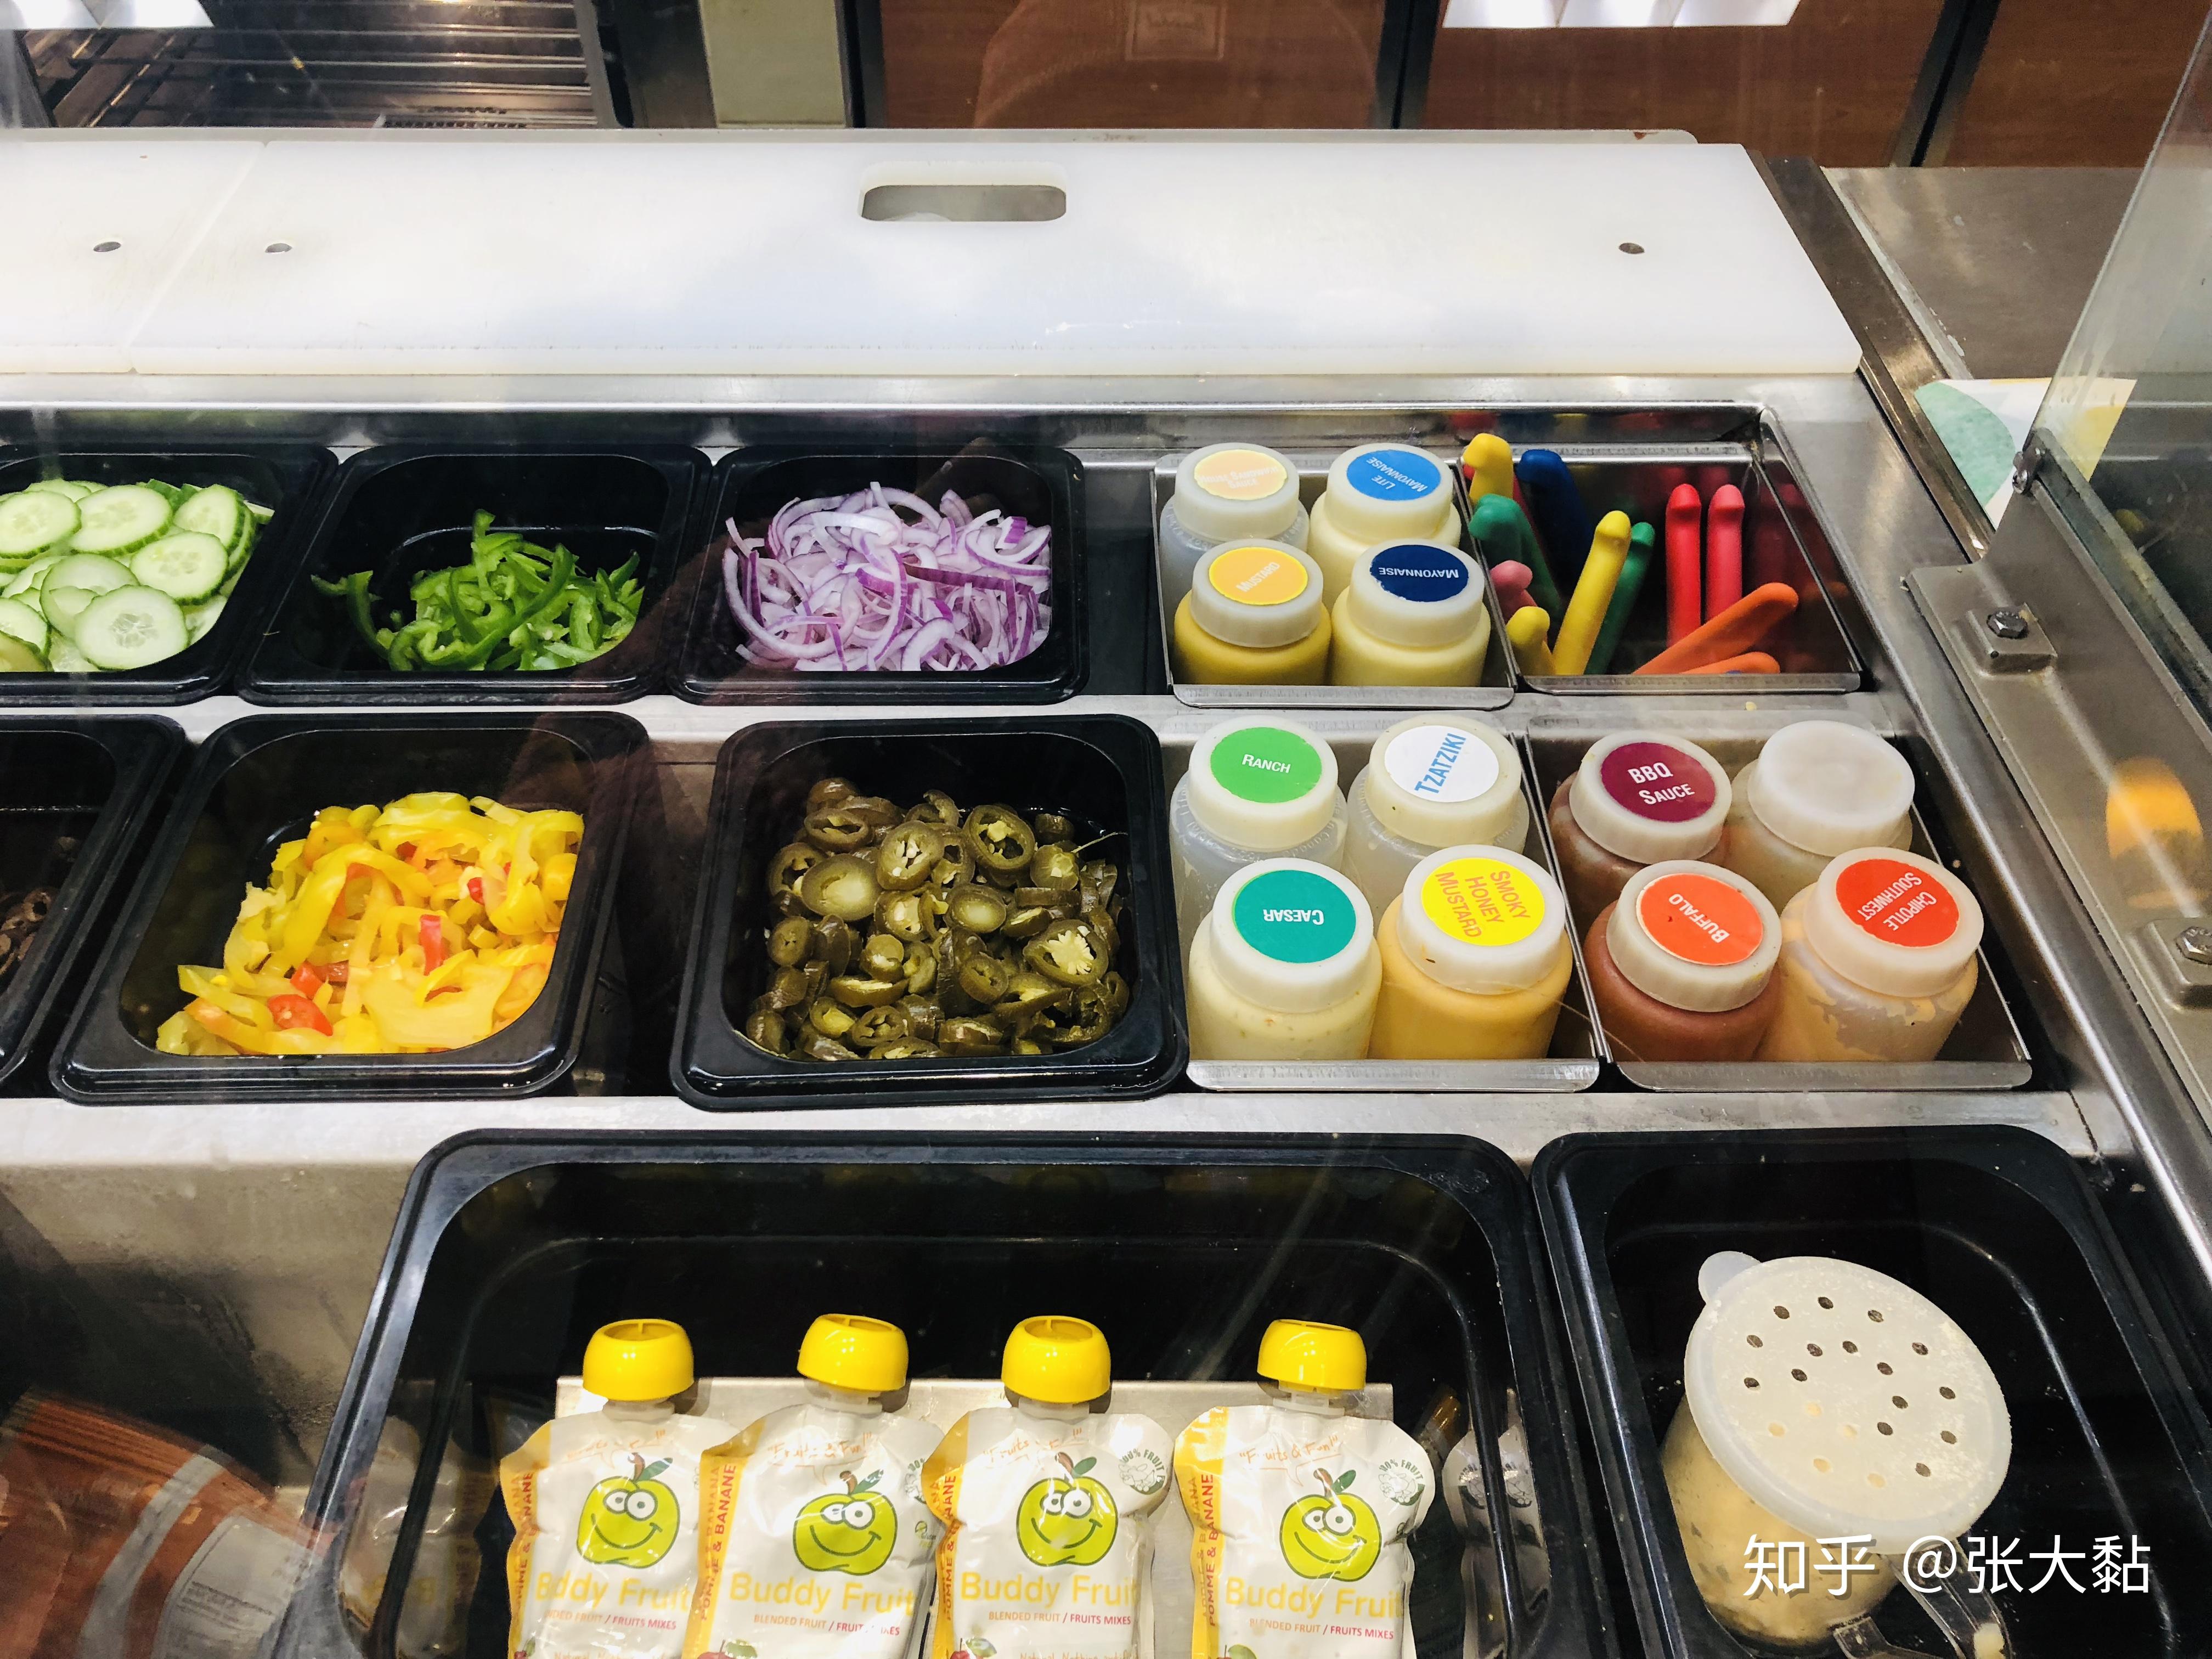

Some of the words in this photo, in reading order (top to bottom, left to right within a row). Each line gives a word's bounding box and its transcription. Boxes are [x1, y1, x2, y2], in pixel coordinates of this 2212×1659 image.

[1366, 457, 1428, 492] MAYONNAISE
[1371, 475, 1396, 489] LITE
[1236, 561, 1280, 593] MUSTARD
[1379, 566, 1459, 579] MAYONNAISE
[1242, 753, 1291, 774] RANCH
[1414, 733, 1466, 795] TZATZIKI
[1627, 762, 1674, 785] BBQ
[1638, 783, 1695, 805] SAUCE
[1435, 871, 1482, 938] MUSTARD
[1465, 875, 1505, 924] HONEY
[1490, 870, 1531, 920] SMOKY
[1858, 872, 1923, 922] SOUTHWEST
[1882, 890, 1937, 931] CHIPOTLE
[1262, 909, 1324, 926] CAESAR
[1668, 893, 1730, 944] BUFFALO
[1291, 1443, 1302, 1458] &
[1401, 1459, 1424, 1479] FRUIT
[714, 1464, 737, 1535] BANANE
[1201, 1474, 1219, 1541] BANANE
[713, 1541, 722, 1552] &
[947, 1540, 955, 1552] &
[1206, 1547, 1216, 1558] &
[618, 1577, 690, 1611] Fruit
[729, 1571, 831, 1615] Buddy
[842, 1581, 916, 1617] Fruit
[960, 1572, 1060, 1609] Buddy
[1206, 1562, 1216, 1627] POMME
[1225, 1577, 1324, 1619] Buddy
[613, 1616, 646, 1628] FRUITS
[648, 1618, 677, 1630] MIXES
[754, 1613, 797, 1626] BLENDED
[799, 1616, 827, 1629] FRUIT
[989, 1611, 1030, 1621] BLENDED
[1034, 1612, 1059, 1622] FRUIT
[1070, 1613, 1102, 1624] FRUITS
[1104, 1615, 1131, 1625] MIXES
[1294, 1623, 1321, 1633] FRUIT
[1330, 1626, 1362, 1637] FRUITS
[1365, 1628, 1394, 1640] MIXES
